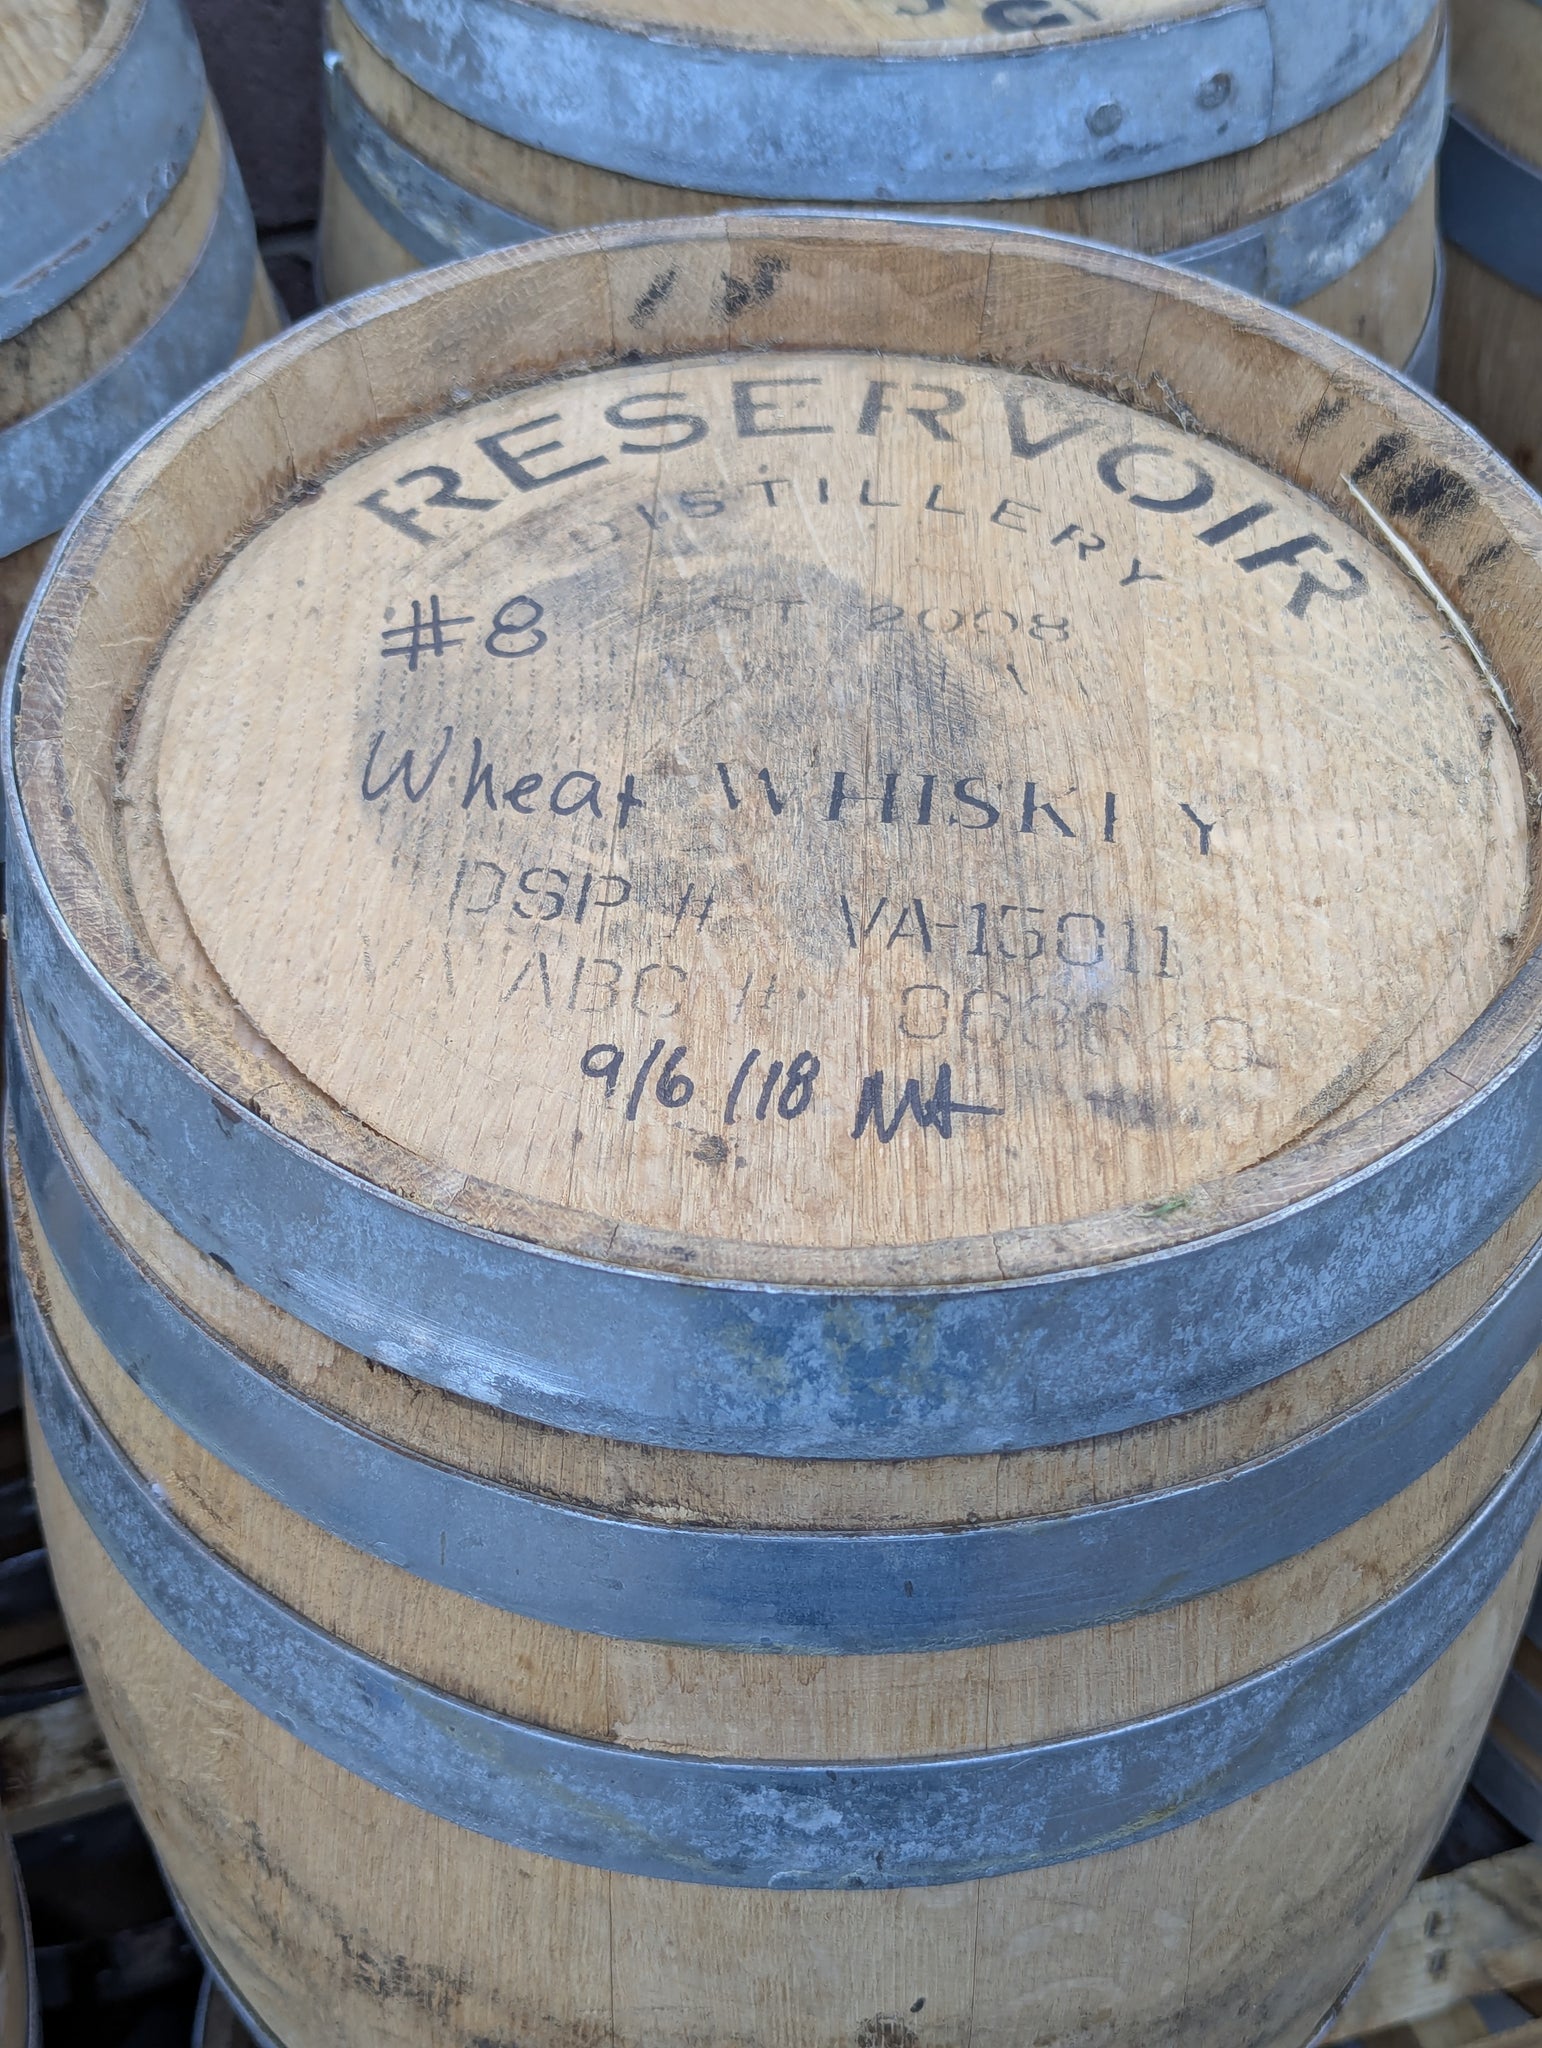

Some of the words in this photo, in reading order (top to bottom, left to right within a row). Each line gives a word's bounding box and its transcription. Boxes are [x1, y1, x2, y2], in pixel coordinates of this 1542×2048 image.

[357, 376, 1371, 618] RESERVOIR
[568, 475, 1164, 588] DISTILLERY
[868, 604, 1070, 643] 2008
[361, 726, 643, 828] Wheat
[448, 858, 632, 924] DSP
[838, 894, 1182, 978] VA-15011
[502, 952, 688, 1019] ABC
